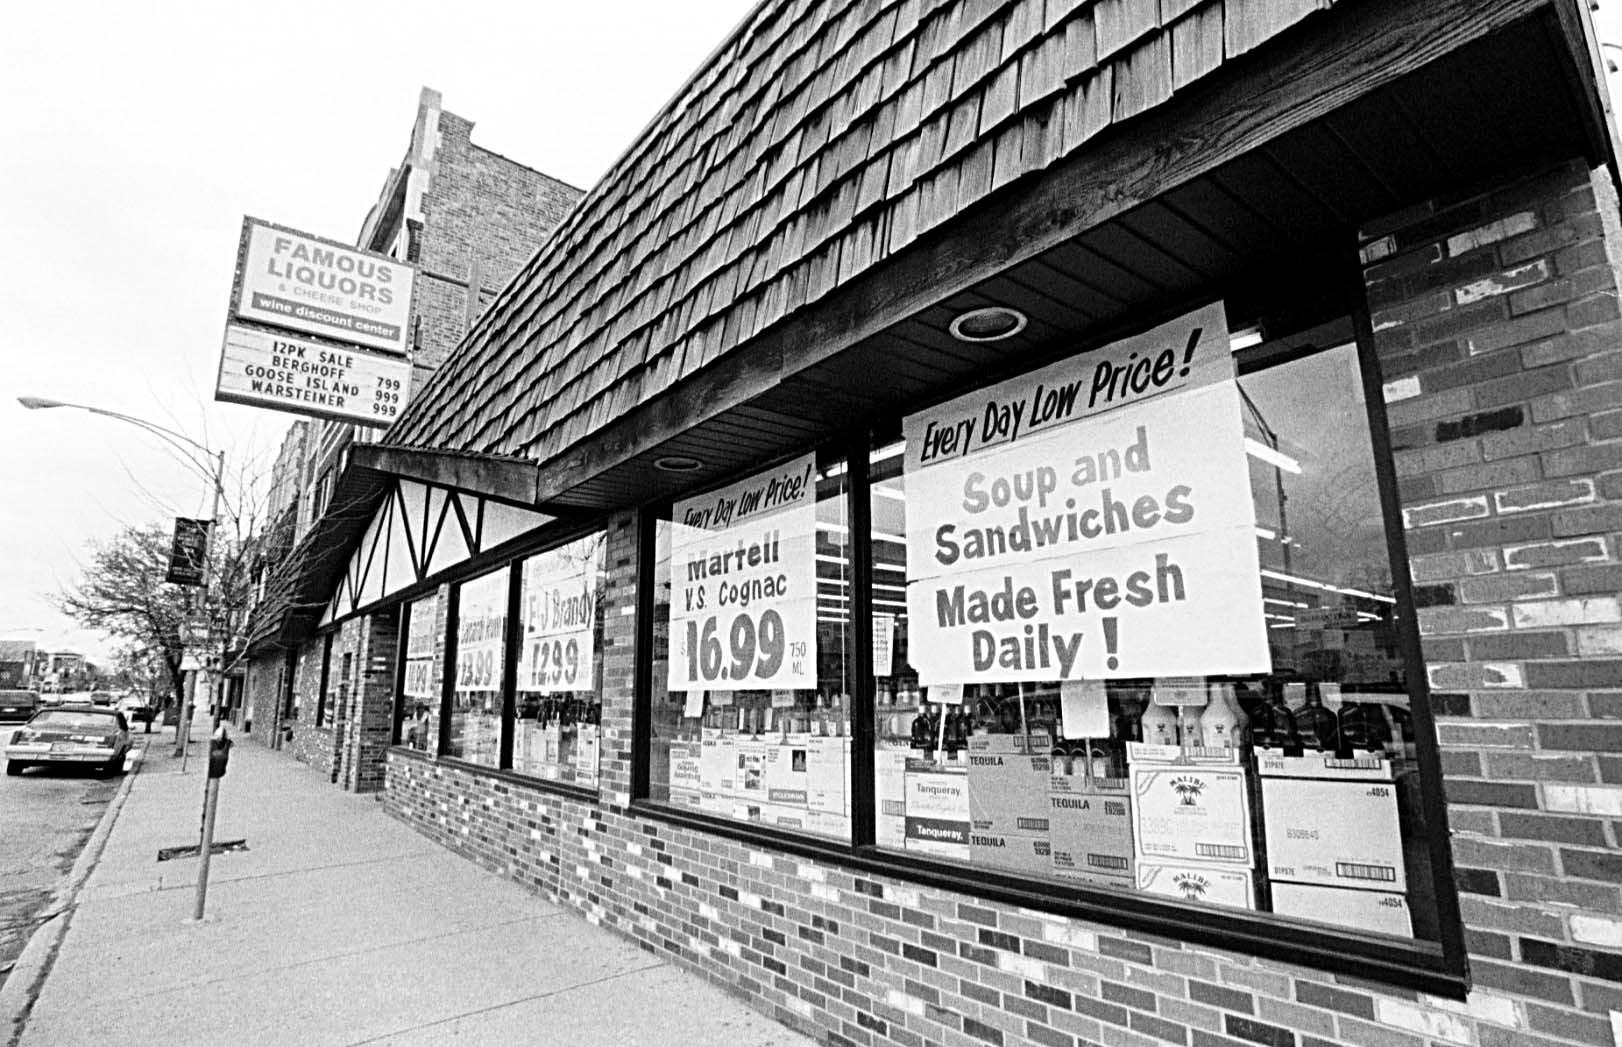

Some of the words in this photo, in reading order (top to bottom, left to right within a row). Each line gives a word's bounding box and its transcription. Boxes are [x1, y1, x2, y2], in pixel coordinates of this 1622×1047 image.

[274, 237, 393, 284] FAMOUS
[267, 257, 393, 305] LIQUORS
[259, 298, 292, 313] wine
[296, 304, 352, 328] discount
[355, 320, 395, 337] center
[294, 286, 343, 306] CHEESE
[350, 300, 382, 315] SHOP
[272, 355, 345, 380] BERGHOFF
[377, 376, 400, 391] 799
[273, 341, 306, 359] 12PK
[319, 352, 353, 368] SALE
[245, 365, 294, 384] GOOSE
[306, 377, 359, 396] ISLAND
[375, 389, 399, 404] 999
[252, 380, 345, 408] WARSTEINER
[372, 403, 397, 417] 999
[920, 416, 977, 463] Every
[981, 400, 1025, 442] Day
[1029, 379, 1082, 428] Low
[1088, 328, 1203, 407] Price!
[962, 464, 1057, 514] Soup
[1070, 425, 1151, 487] and
[683, 508, 713, 529] Every
[713, 498, 736, 527] Day
[737, 487, 763, 517] Low
[764, 464, 812, 508] Price!
[934, 484, 1195, 565] Sandwiches
[687, 529, 779, 581] Martell
[552, 580, 596, 630] Brandy
[719, 574, 787, 607] Cognac
[936, 576, 1039, 628] Made
[1051, 552, 1186, 615] Fresh
[686, 609, 785, 682] 16.99
[789, 642, 806, 657] 750
[971, 623, 1083, 679] Daily
[792, 660, 805, 675] ML
[969, 756, 1004, 766] TEQUILA
[917, 783, 960, 798] Tanqueray
[1169, 775, 1207, 789] MALIBU
[1051, 798, 1090, 810] TEQUILA
[971, 836, 1006, 848] TEQUILA
[1173, 872, 1211, 887] MALIBU
